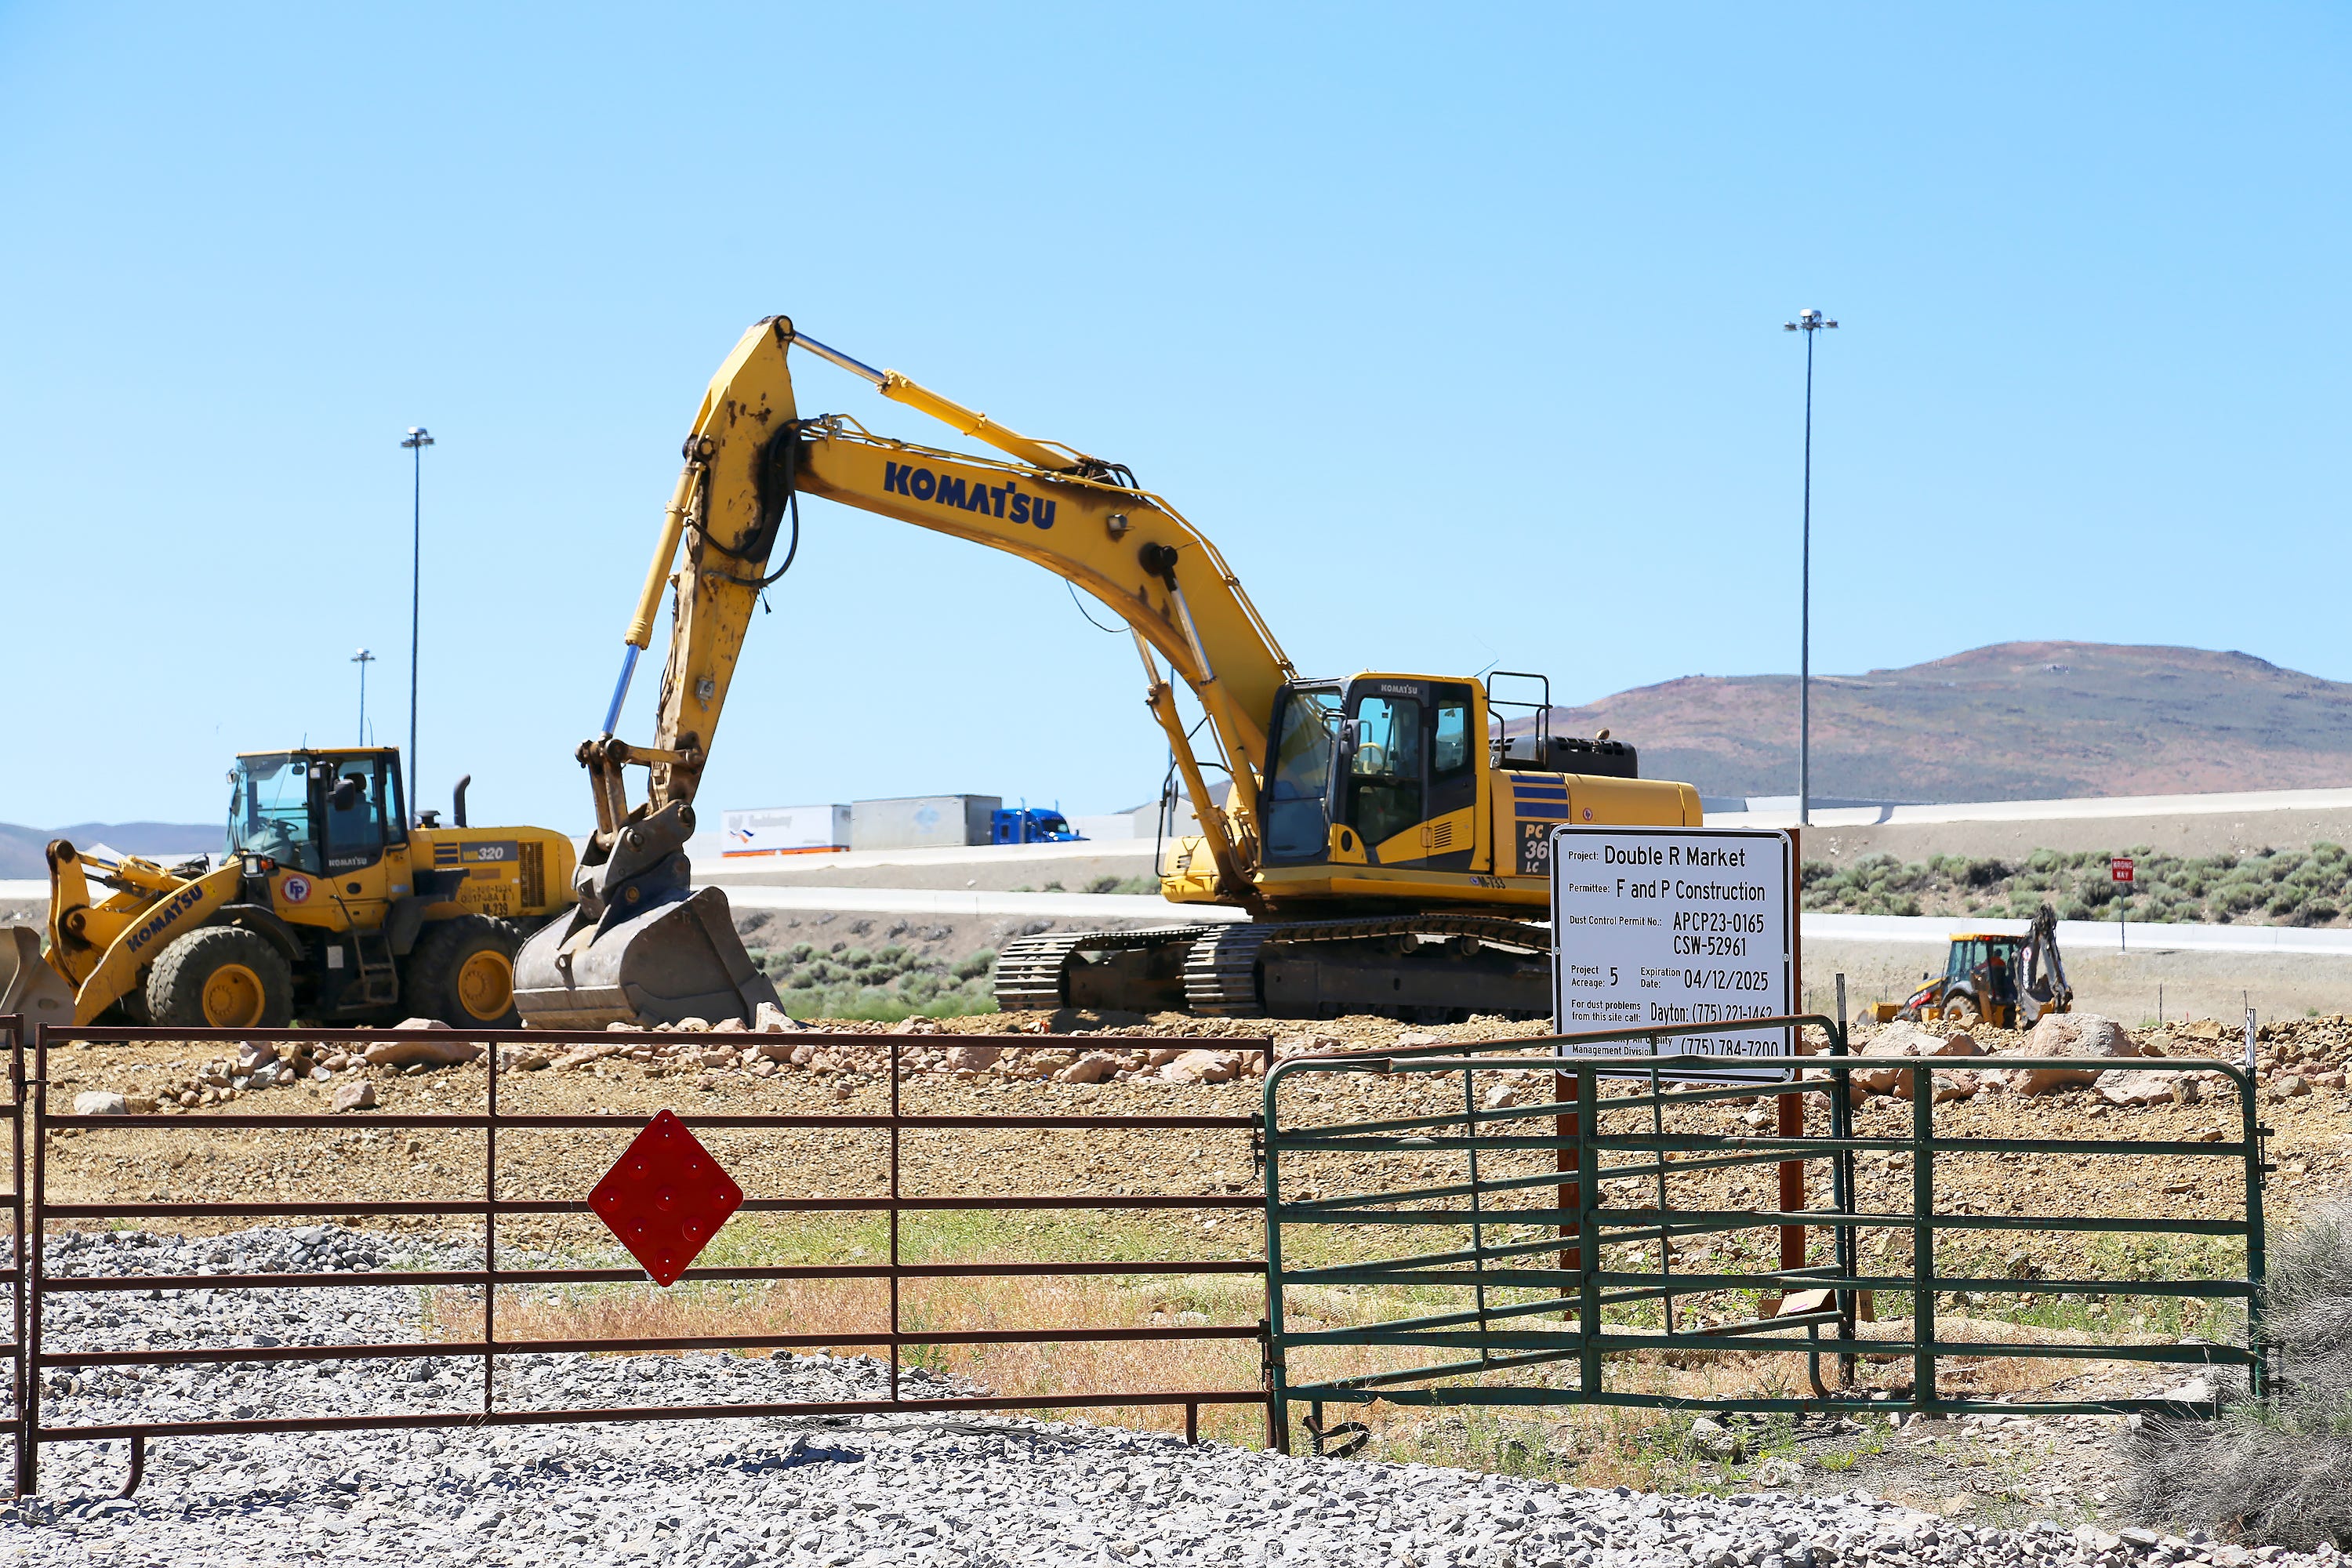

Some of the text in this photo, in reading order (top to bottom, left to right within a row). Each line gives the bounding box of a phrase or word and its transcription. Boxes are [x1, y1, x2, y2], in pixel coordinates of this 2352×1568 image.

[884, 461, 1056, 530] KOMATSU
[1381, 684, 1418, 695] KOMATSU
[1525, 824, 1544, 839] PC
[1525, 840, 1551, 859] 36
[1568, 845, 1745, 867] Project: Double R Market
[328, 856, 368, 866] KOMATSU
[1525, 862, 1540, 873] LC
[1569, 879, 1766, 902] Permittee: F and P Construction
[126, 884, 204, 953] KOMATSU
[1570, 911, 1764, 934] Dust Control Permit No.: APCP23-0165
[1673, 935, 1747, 956] CSW-52961
[1571, 964, 1599, 976] Project
[1610, 967, 1619, 986] 5
[1640, 967, 1681, 977] Expiration
[1571, 977, 1606, 989] Acreage:
[1640, 978, 1661, 989] Date:
[1684, 969, 1769, 991] 04/12/2025
[1571, 999, 1641, 1011] For dust problems
[1650, 1002, 1773, 1025] Dayton: (775) 221-1462
[1572, 1011, 1641, 1022] from this site call:
[1572, 1045, 1622, 1057] Management
[1681, 1037, 1779, 1056] (775) 784-7200
